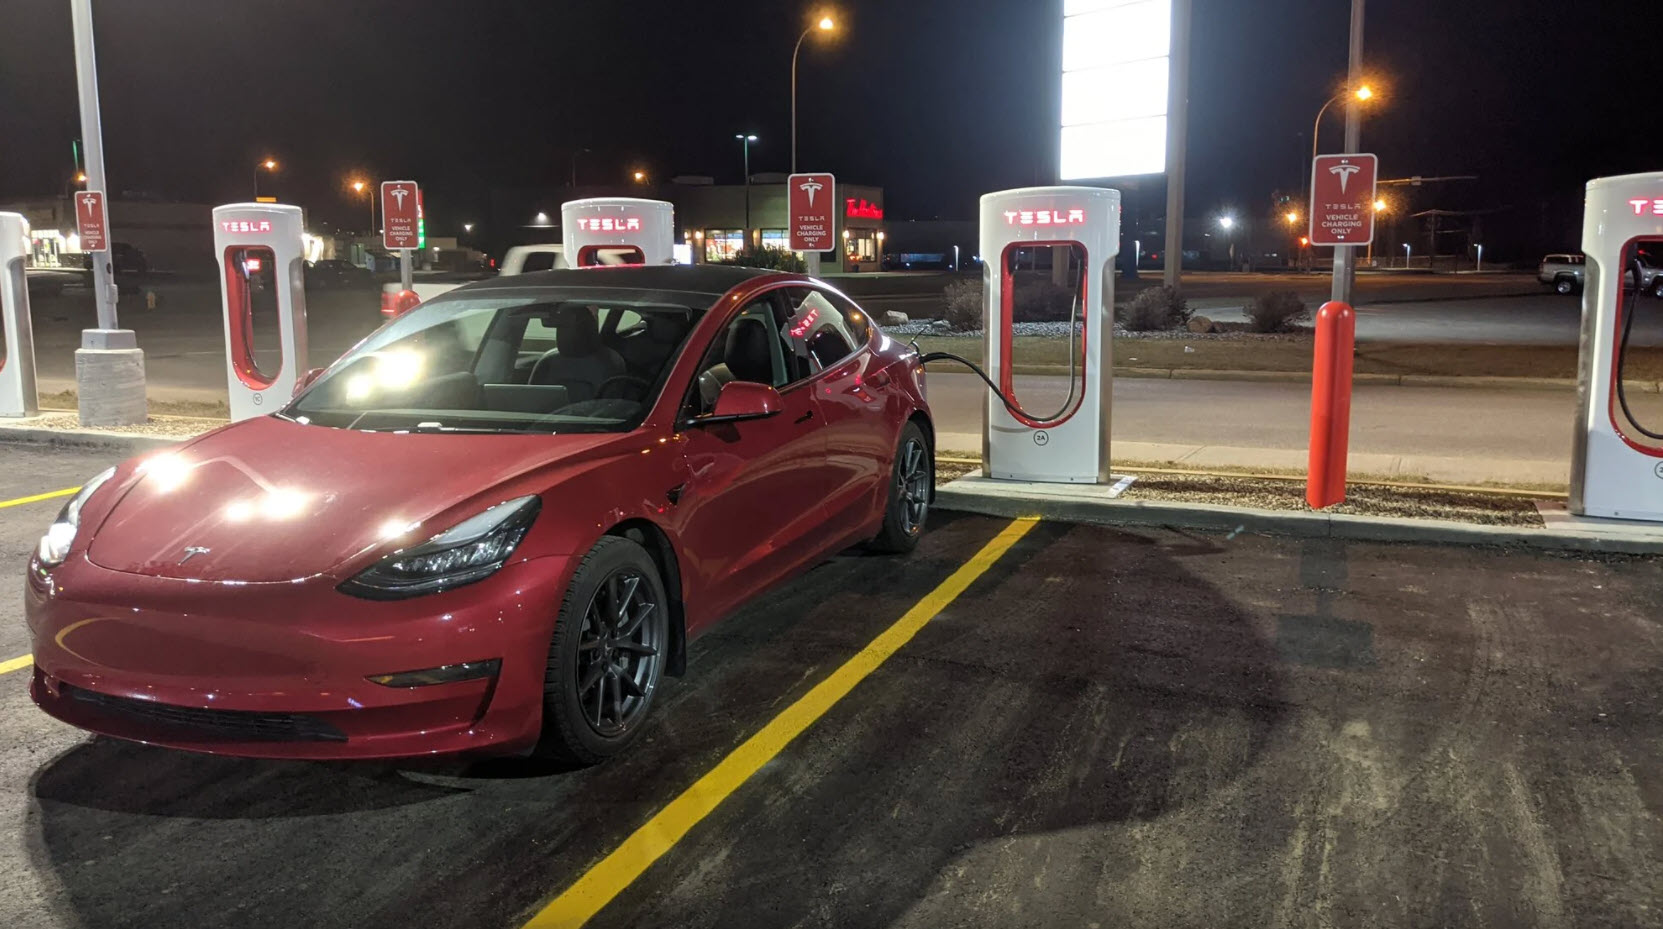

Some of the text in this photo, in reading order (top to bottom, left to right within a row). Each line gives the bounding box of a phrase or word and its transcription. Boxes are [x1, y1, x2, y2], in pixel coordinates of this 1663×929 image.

[1003, 209, 1084, 225] TESLA
[222, 221, 270, 232] TESLA
[577, 218, 640, 231] TESLA
